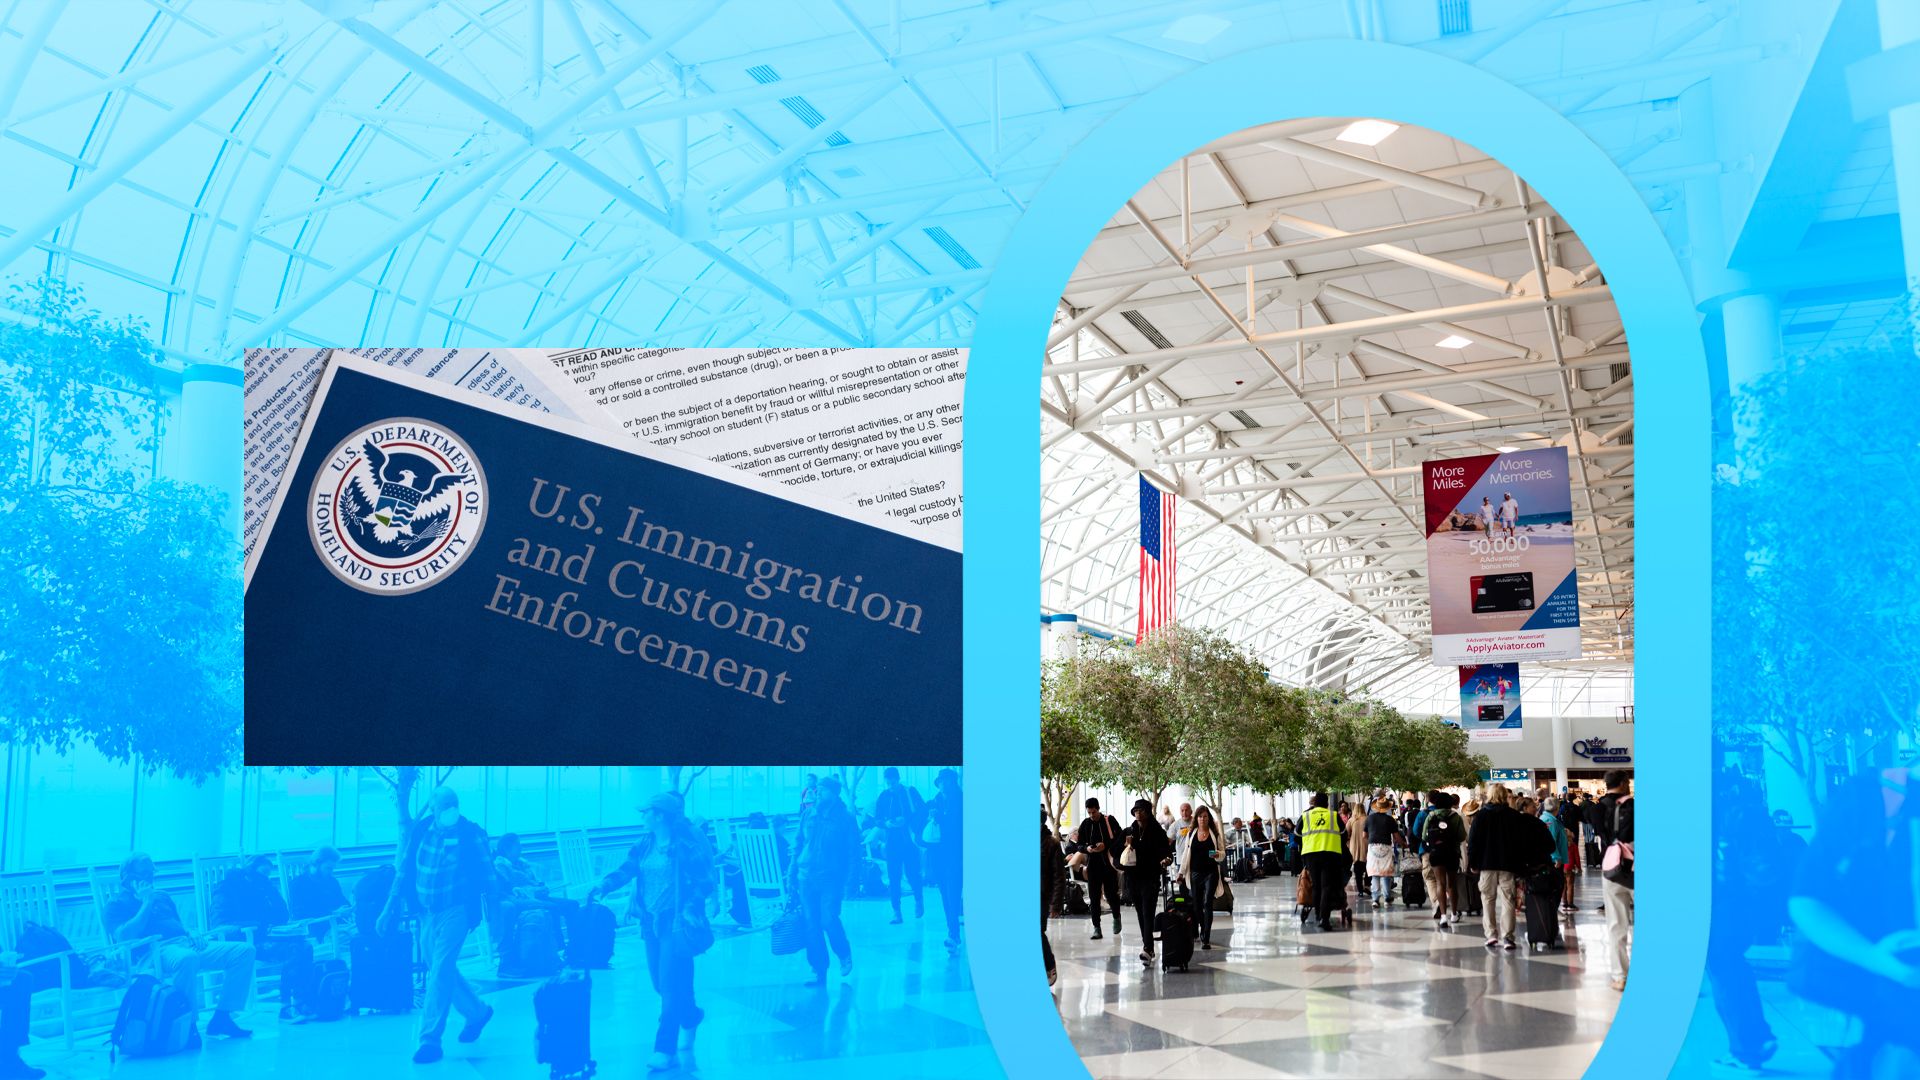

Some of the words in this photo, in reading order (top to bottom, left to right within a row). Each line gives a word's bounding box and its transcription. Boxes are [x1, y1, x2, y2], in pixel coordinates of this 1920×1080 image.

[257, 355, 270, 367] are
[268, 363, 276, 372] at
[274, 352, 288, 364] the
[490, 358, 498, 368] of
[567, 351, 597, 365] READ
[570, 362, 598, 374] within
[600, 354, 635, 368] specific
[481, 366, 507, 391] United
[573, 371, 596, 384] you?
[588, 385, 606, 395] any
[607, 377, 642, 391] offense
[644, 374, 654, 383] or
[656, 368, 685, 380] crime,
[687, 362, 710, 373] even
[711, 353, 745, 368] though
[610, 394, 620, 403] or
[622, 388, 642, 400] sold
[644, 388, 651, 396] a
[652, 375, 698, 393] controlled
[700, 366, 748, 383] substance
[750, 358, 782, 373] (drug),
[783, 355, 793, 364] or
[794, 350, 820, 362] been
[821, 348, 829, 356] a
[622, 420, 633, 428] or
[634, 414, 659, 426] been
[660, 410, 676, 420] the
[678, 401, 712, 416] subject
[713, 397, 723, 408] of
[725, 398, 732, 406] a
[733, 386, 787, 404] deportation
[788, 377, 828, 391] hearing,
[829, 374, 839, 382] or
[841, 365, 874, 380] sought
[875, 364, 886, 372] to
[887, 356, 917, 370] obtain
[918, 354, 928, 362] or
[930, 348, 959, 360] assist
[641, 424, 662, 436] U.S.
[664, 413, 720, 431] immigration
[720, 404, 754, 419] benefit
[755, 402, 767, 412] by
[769, 395, 794, 408] fraud
[796, 394, 806, 402] or
[807, 386, 835, 399] willful
[836, 369, 920, 394] misrepresentation
[922, 366, 932, 374] or
[934, 360, 959, 372] other
[679, 426, 710, 441] school
[712, 424, 725, 433] on
[726, 415, 763, 431] student
[764, 411, 778, 424] (F)
[780, 406, 810, 418] status
[811, 403, 821, 412] or
[823, 401, 831, 409] a
[832, 394, 861, 409] public
[862, 383, 911, 400] secondary
[913, 374, 945, 389] school
[248, 423, 262, 439] and
[262, 390, 297, 426] prohibited
[260, 421, 284, 443] plants,
[283, 400, 302, 420] plant
[752, 437, 804, 454] subversive
[806, 434, 816, 443] or
[818, 424, 856, 440] terrorist
[857, 416, 902, 432] activities,
[903, 412, 913, 421] or
[915, 408, 933, 419] any
[935, 402, 960, 414] other
[250, 451, 264, 467] and
[265, 433, 284, 452] other
[284, 420, 298, 433] live
[773, 454, 786, 463] as
[787, 443, 829, 460] currently
[831, 430, 884, 450] designated
[885, 429, 897, 439] by
[899, 425, 915, 435] the
[916, 419, 939, 431] U.S.
[802, 459, 812, 470] of
[863, 447, 873, 456] or
[874, 442, 899, 454] have
[901, 438, 920, 450] you
[921, 432, 942, 444] ever
[259, 453, 280, 472] items
[280, 444, 291, 452] to
[331, 446, 361, 472] U.S.
[371, 426, 478, 487] DEPARTMENT
[464, 491, 480, 515] OF
[820, 465, 856, 478] torture,
[857, 462, 868, 470] or
[869, 447, 927, 468] extrajudicial
[1432, 466, 1465, 478] More
[1499, 459, 1532, 471] More
[254, 478, 269, 494] and
[857, 497, 874, 507] the
[875, 488, 907, 503] United
[909, 480, 945, 496] States?
[892, 504, 917, 517] legal
[918, 496, 956, 511] custody
[951, 507, 961, 518] of
[316, 492, 373, 581] HOMELAND
[379, 532, 467, 586] SECURITY
[1469, 535, 1530, 556] 50,000
[529, 476, 604, 535] U.S.
[617, 505, 924, 635] Immigration
[1502, 561, 1520, 569] miles
[507, 535, 596, 586] and
[608, 559, 811, 654] Customs
[484, 573, 792, 705] Enforcement
[1466, 641, 1545, 653] ApplyAviator.com
